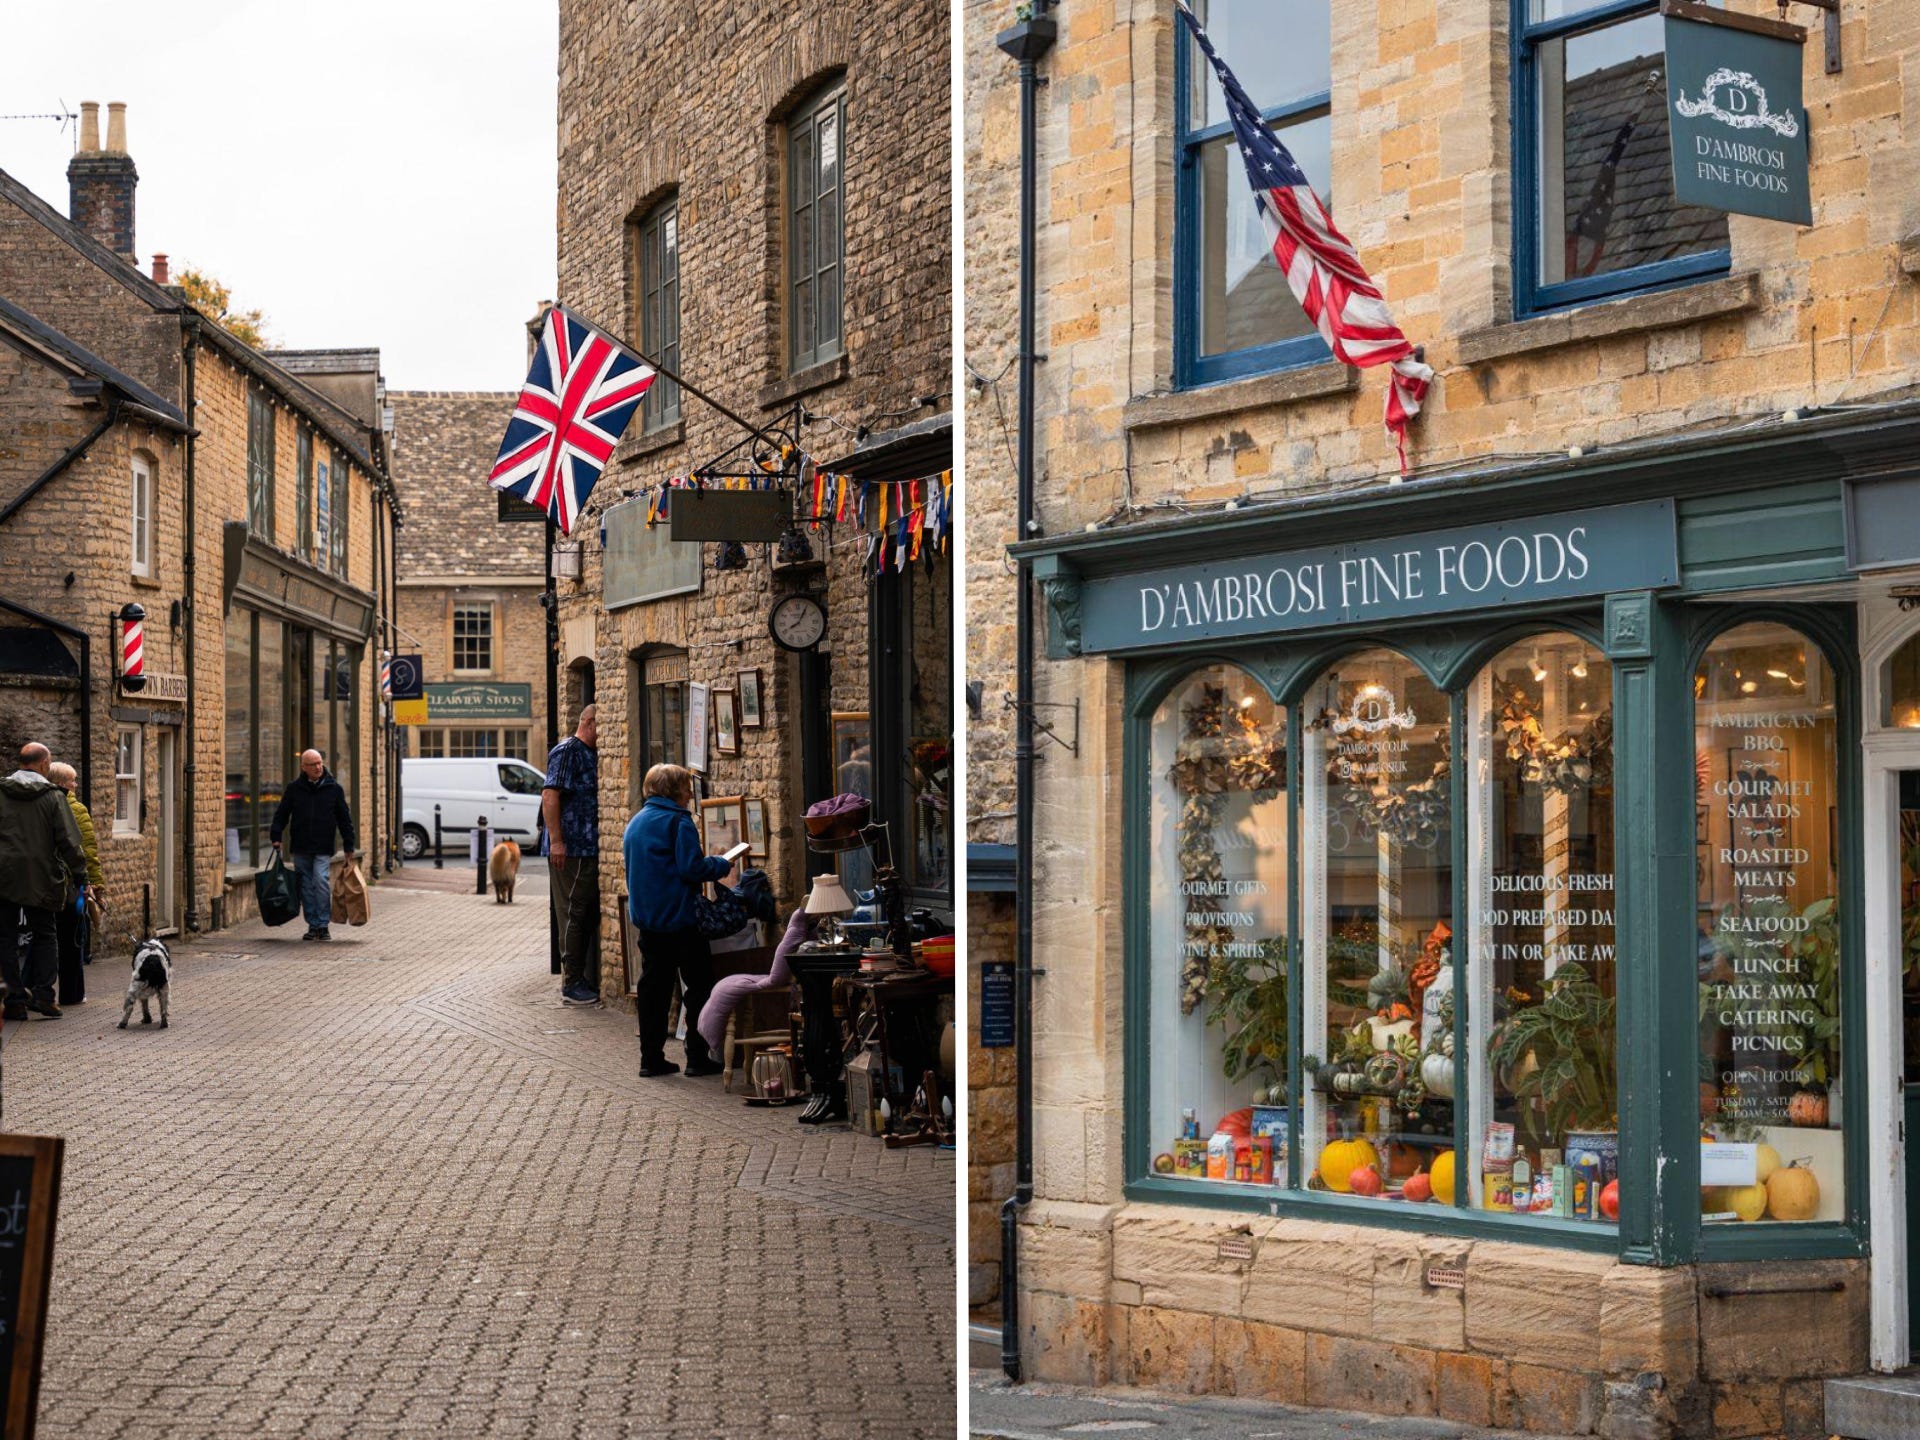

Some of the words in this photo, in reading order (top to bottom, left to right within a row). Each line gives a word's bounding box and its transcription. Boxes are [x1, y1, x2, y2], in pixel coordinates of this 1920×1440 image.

[1730, 89, 1746, 112] D
[1696, 135, 1786, 170] D'AMBROSI
[1697, 162, 1730, 184] FINE
[1735, 168, 1788, 194] FOODS
[1140, 564, 1326, 631] D'AMBROSI
[1340, 551, 1424, 608] FINE
[1438, 526, 1590, 595] FOODS
[160, 678, 186, 698] BARBERS
[487, 696, 524, 705] STOVES
[1368, 701, 1380, 720] D
[1710, 712, 1816, 728] AMERICAN
[1744, 736, 1784, 752] BBQ
[1714, 780, 1814, 796] GOURMET
[1727, 804, 1800, 818] SALADS
[1720, 848, 1808, 864] ROASTED
[1490, 874, 1564, 892] DELICIOUS
[1568, 874, 1614, 890] FRESH
[1734, 872, 1796, 886] MEATS
[1234, 880, 1268, 896] GIFTS
[1186, 912, 1254, 926] PROVISIONS
[1513, 910, 1587, 926] PREPARED
[1720, 916, 1810, 932] SEAFOOD
[1209, 944, 1218, 958] &
[1222, 942, 1264, 958] SPIRITS
[1502, 944, 1518, 960] IN
[1522, 944, 1544, 960] OR
[1549, 944, 1586, 960] TAKE
[1734, 959, 1800, 974] LUNCH
[1714, 984, 1766, 1000] TAKE
[1769, 984, 1820, 1000] AWAY
[1720, 1010, 1814, 1025] CATERING
[1732, 1036, 1804, 1050] PICNICS
[1722, 1070, 1759, 1084] OPEN
[1763, 1070, 1810, 1084] HOURS
